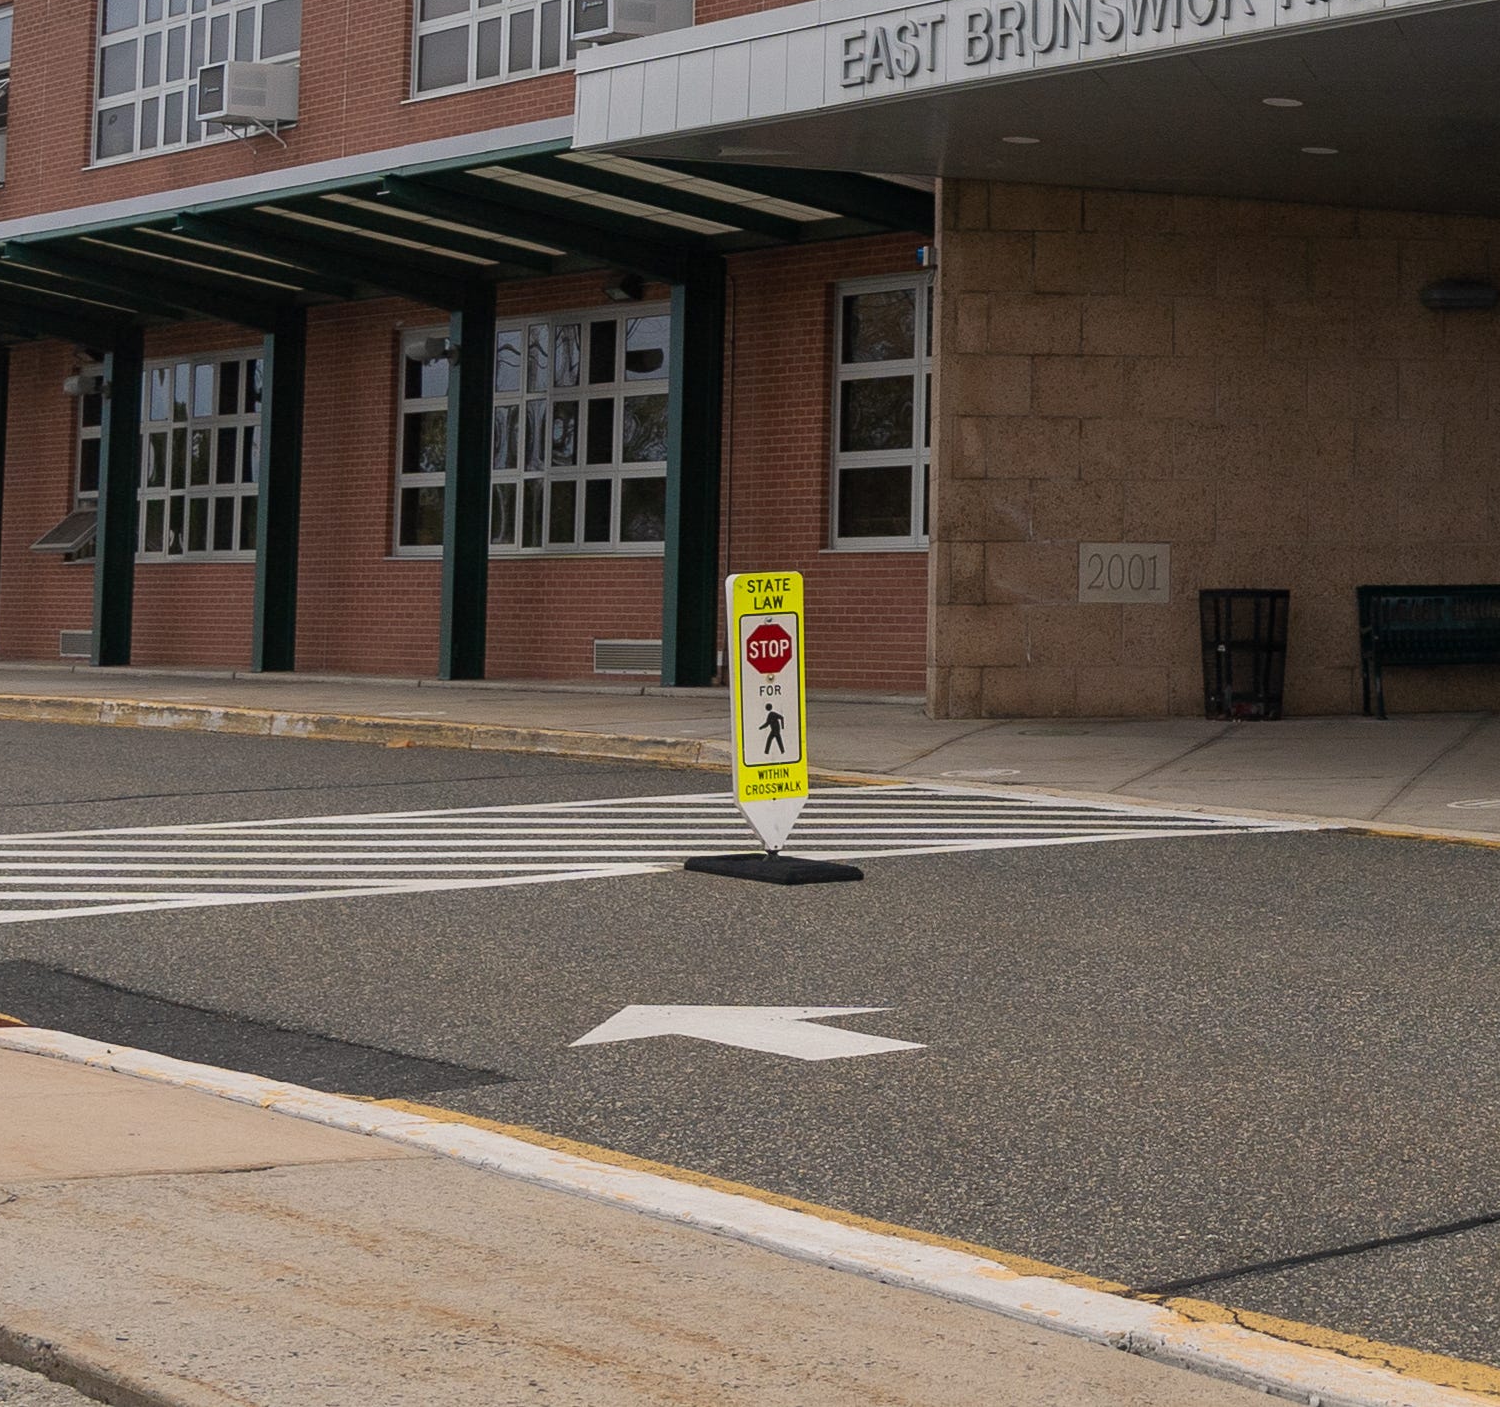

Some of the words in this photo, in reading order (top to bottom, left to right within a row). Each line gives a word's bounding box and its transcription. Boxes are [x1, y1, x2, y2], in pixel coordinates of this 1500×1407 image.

[840, 11, 948, 90] EAST
[1087, 553, 1162, 591] 2001
[747, 578, 791, 594] STATE
[753, 595, 784, 610] LAW
[749, 639, 790, 660] STOP
[759, 685, 782, 696] FOR
[757, 768, 790, 781] WITHIN
[745, 780, 802, 796] CROSSWALK
